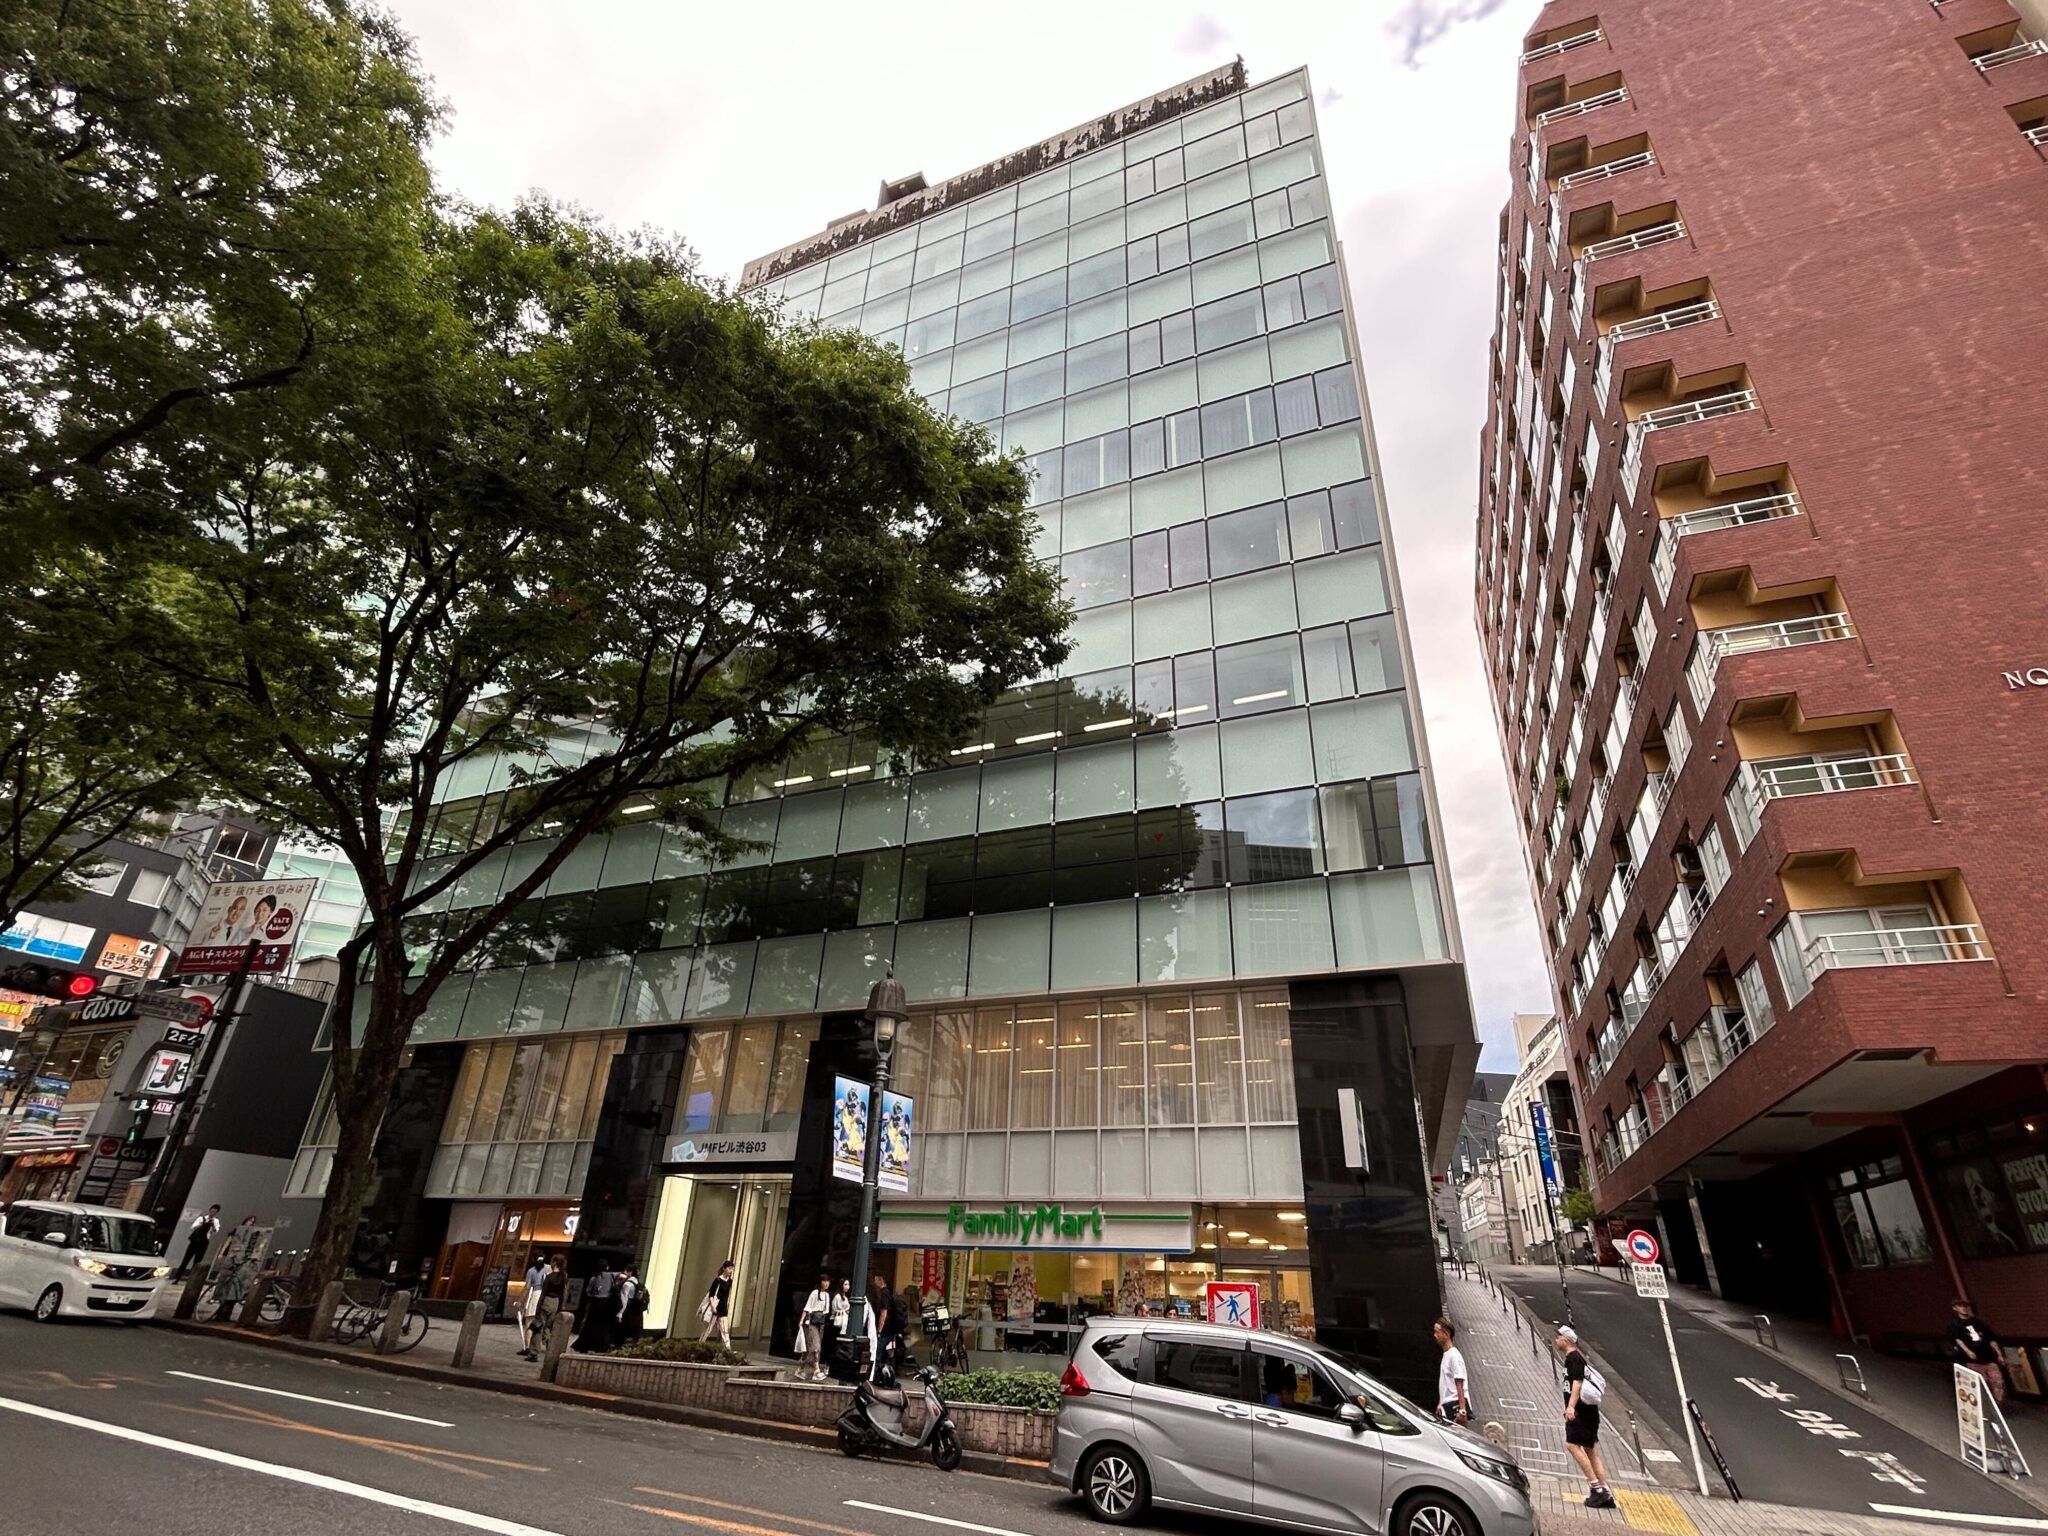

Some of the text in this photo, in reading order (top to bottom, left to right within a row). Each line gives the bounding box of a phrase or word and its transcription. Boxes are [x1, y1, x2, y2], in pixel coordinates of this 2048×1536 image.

[168, 1030, 188, 1043] 2F
[155, 1102, 173, 1113] ATM
[947, 1204, 1102, 1245] FamilyMart
